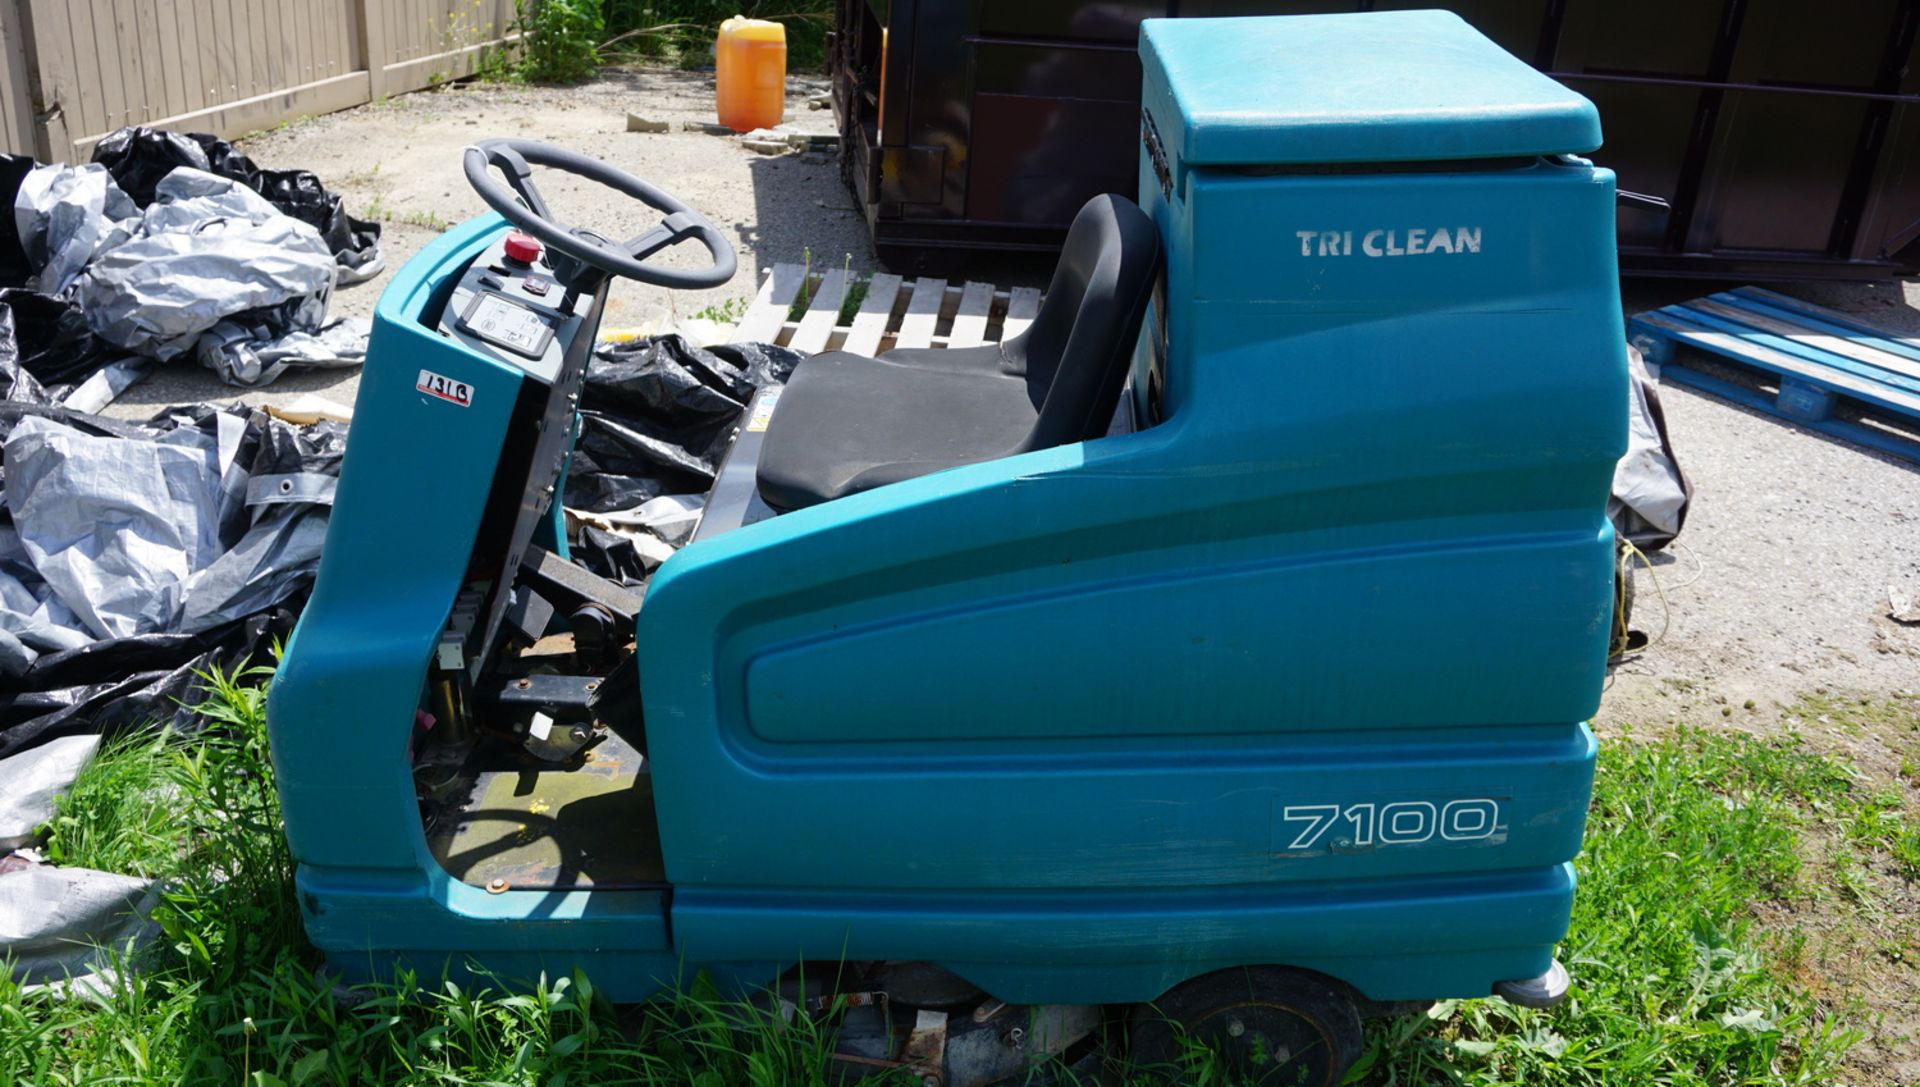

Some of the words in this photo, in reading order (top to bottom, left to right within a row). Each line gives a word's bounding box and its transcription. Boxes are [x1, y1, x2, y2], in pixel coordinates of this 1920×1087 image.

[1295, 229, 1352, 257] TRI
[1361, 226, 1482, 257] CLEAN
[426, 375, 468, 402] 131B
[1283, 799, 1499, 849] 7100
